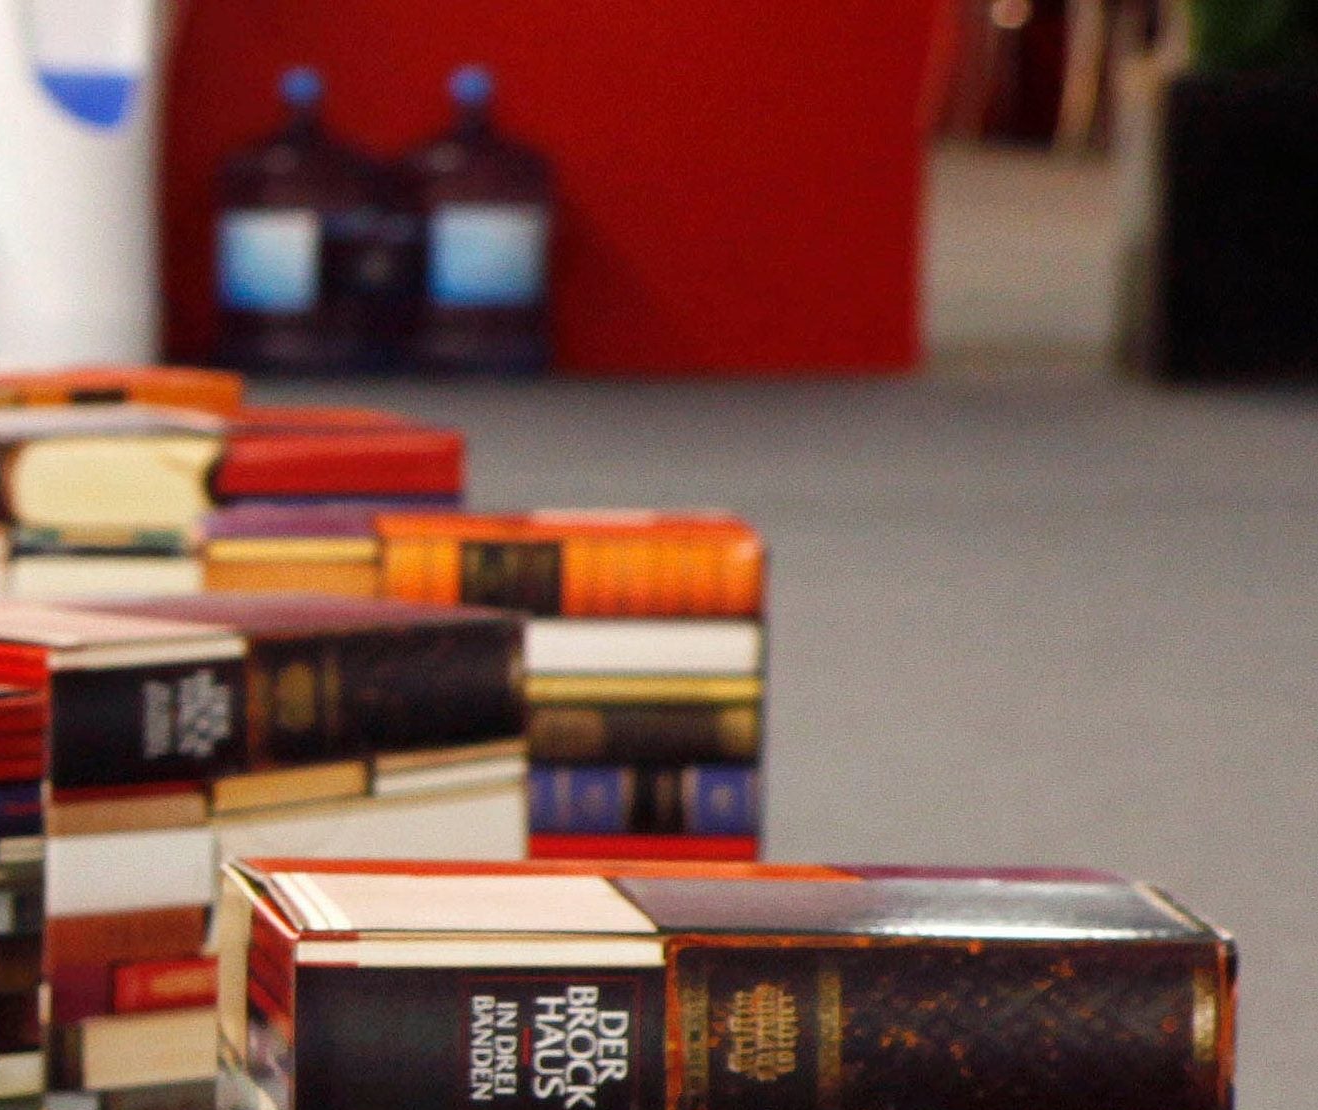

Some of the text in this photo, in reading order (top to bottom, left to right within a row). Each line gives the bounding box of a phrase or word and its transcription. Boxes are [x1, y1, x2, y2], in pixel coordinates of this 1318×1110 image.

[494, 1001, 518, 1096] IN DREI
[533, 996, 566, 1100] HAUS
[564, 985, 599, 1110] BROCK
[597, 1010, 630, 1085] DER
